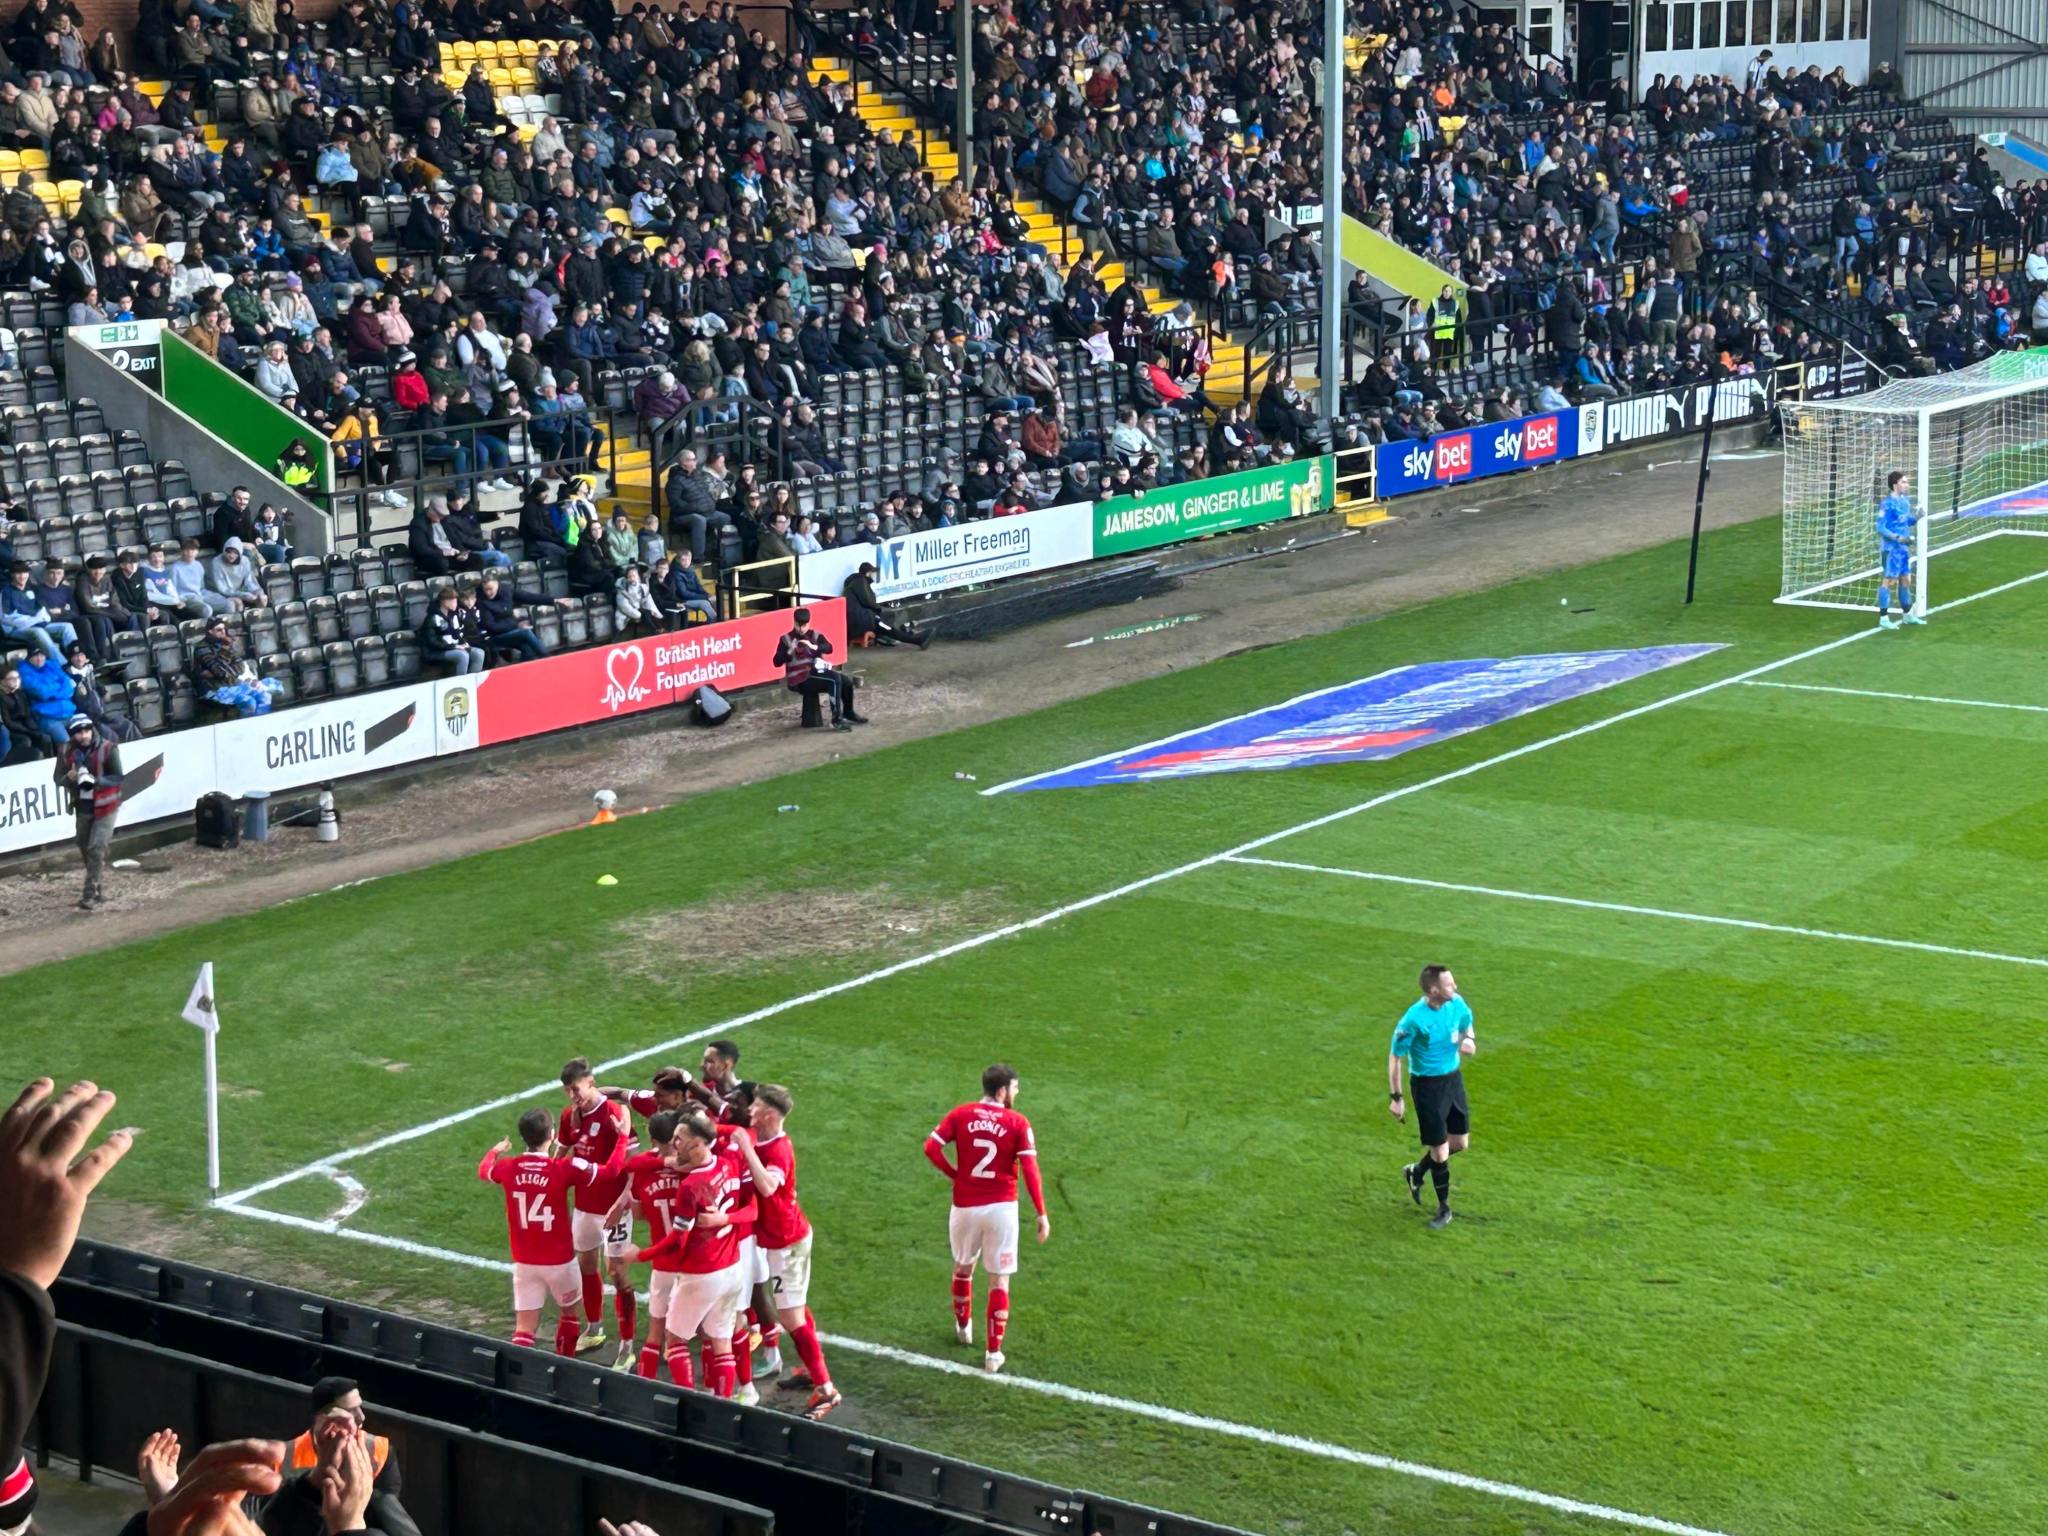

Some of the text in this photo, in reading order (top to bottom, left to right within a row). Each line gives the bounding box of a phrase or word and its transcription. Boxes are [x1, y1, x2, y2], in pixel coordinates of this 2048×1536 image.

[131, 357, 156, 371] EXIT
[1606, 394, 1667, 444] PUMA
[1403, 441, 1469, 480] sky bet
[1495, 423, 1555, 461] sky bet
[1102, 502, 1179, 537] JAMESON,
[1183, 489, 1239, 520] GINGER
[1240, 487, 1250, 508] &
[1252, 480, 1285, 505] LIME
[916, 527, 1030, 563] Miller Freeman
[655, 632, 742, 667] British Heart
[656, 661, 735, 691] Foundation
[265, 720, 356, 769] CARLING
[971, 1138, 998, 1179] 2
[512, 1190, 556, 1232] 14
[607, 1222, 628, 1243] 25
